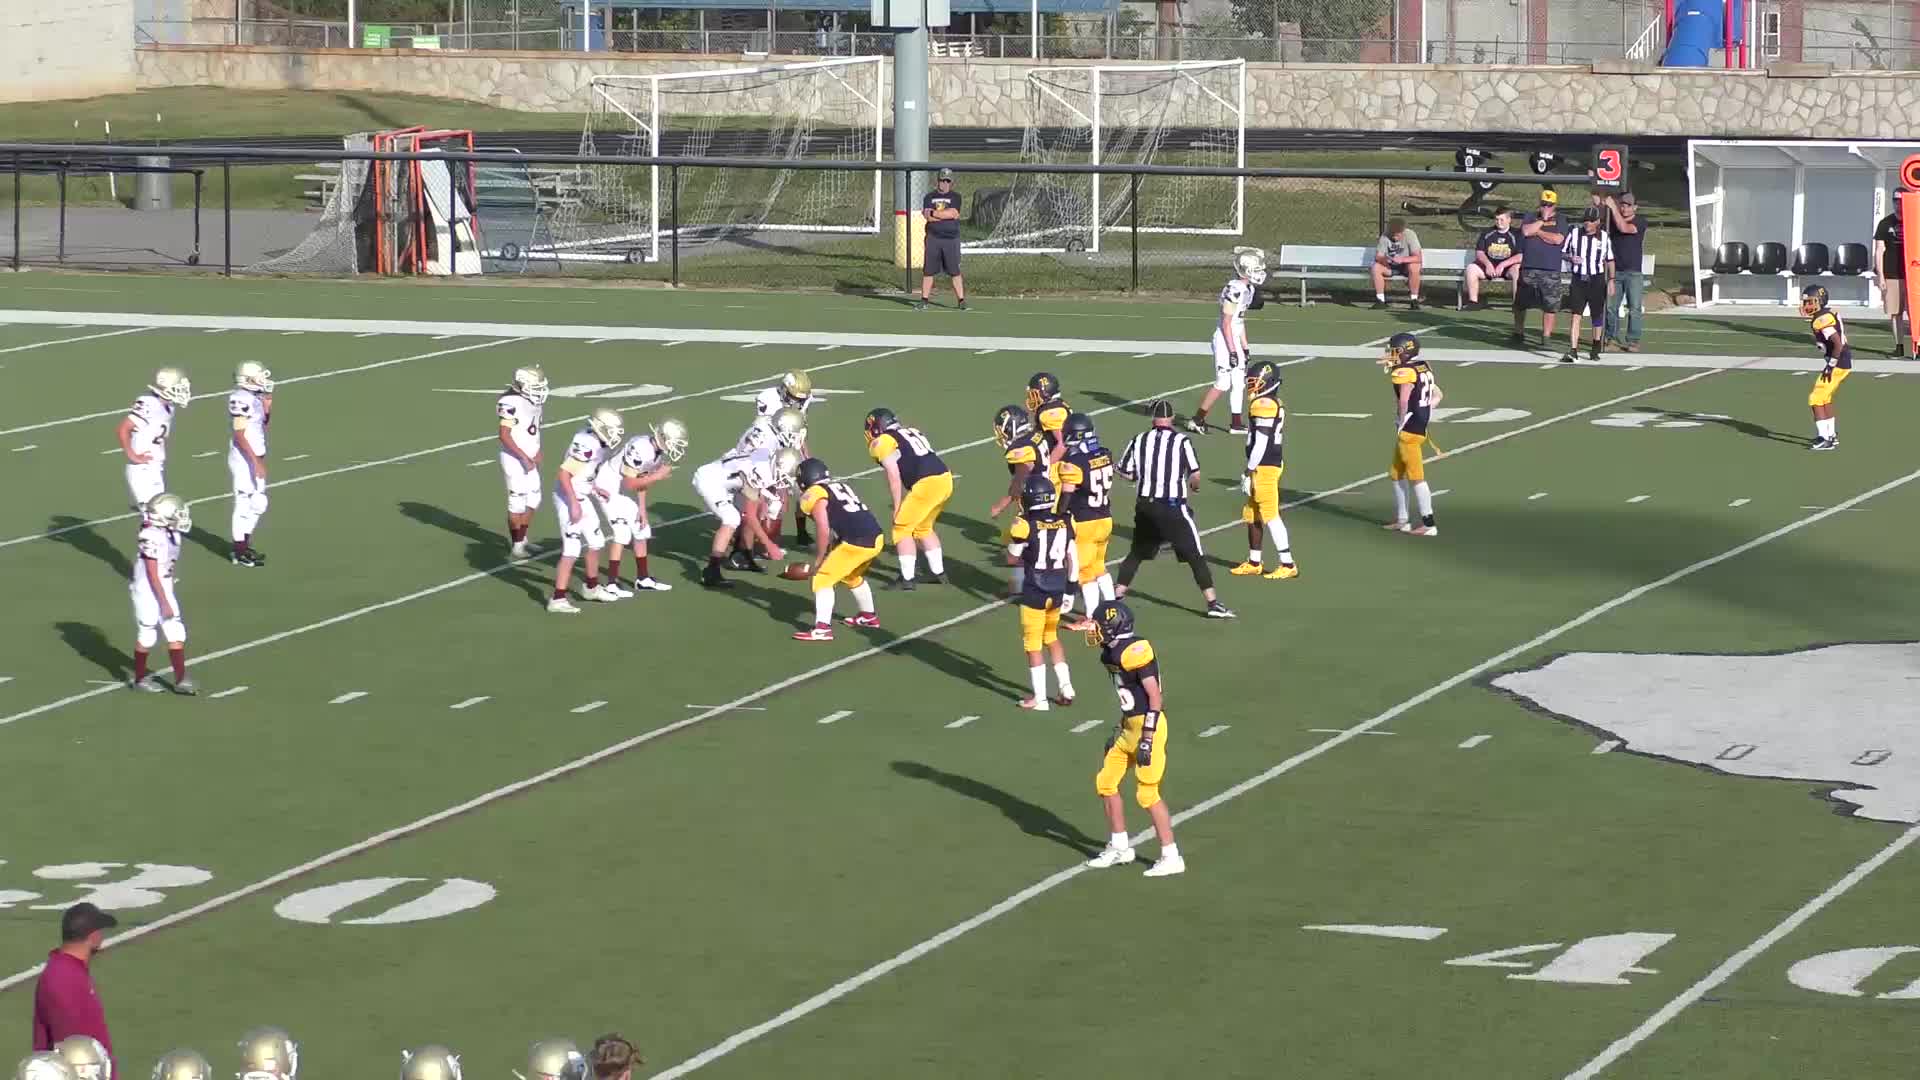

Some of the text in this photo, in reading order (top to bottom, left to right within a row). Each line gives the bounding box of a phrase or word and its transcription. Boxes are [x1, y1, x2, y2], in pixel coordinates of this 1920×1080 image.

[1597, 150, 1621, 181] 3
[152, 424, 168, 445] 2
[1088, 464, 1114, 508] 55
[1034, 527, 1067, 570] 14
[1104, 607, 1118, 621] 16
